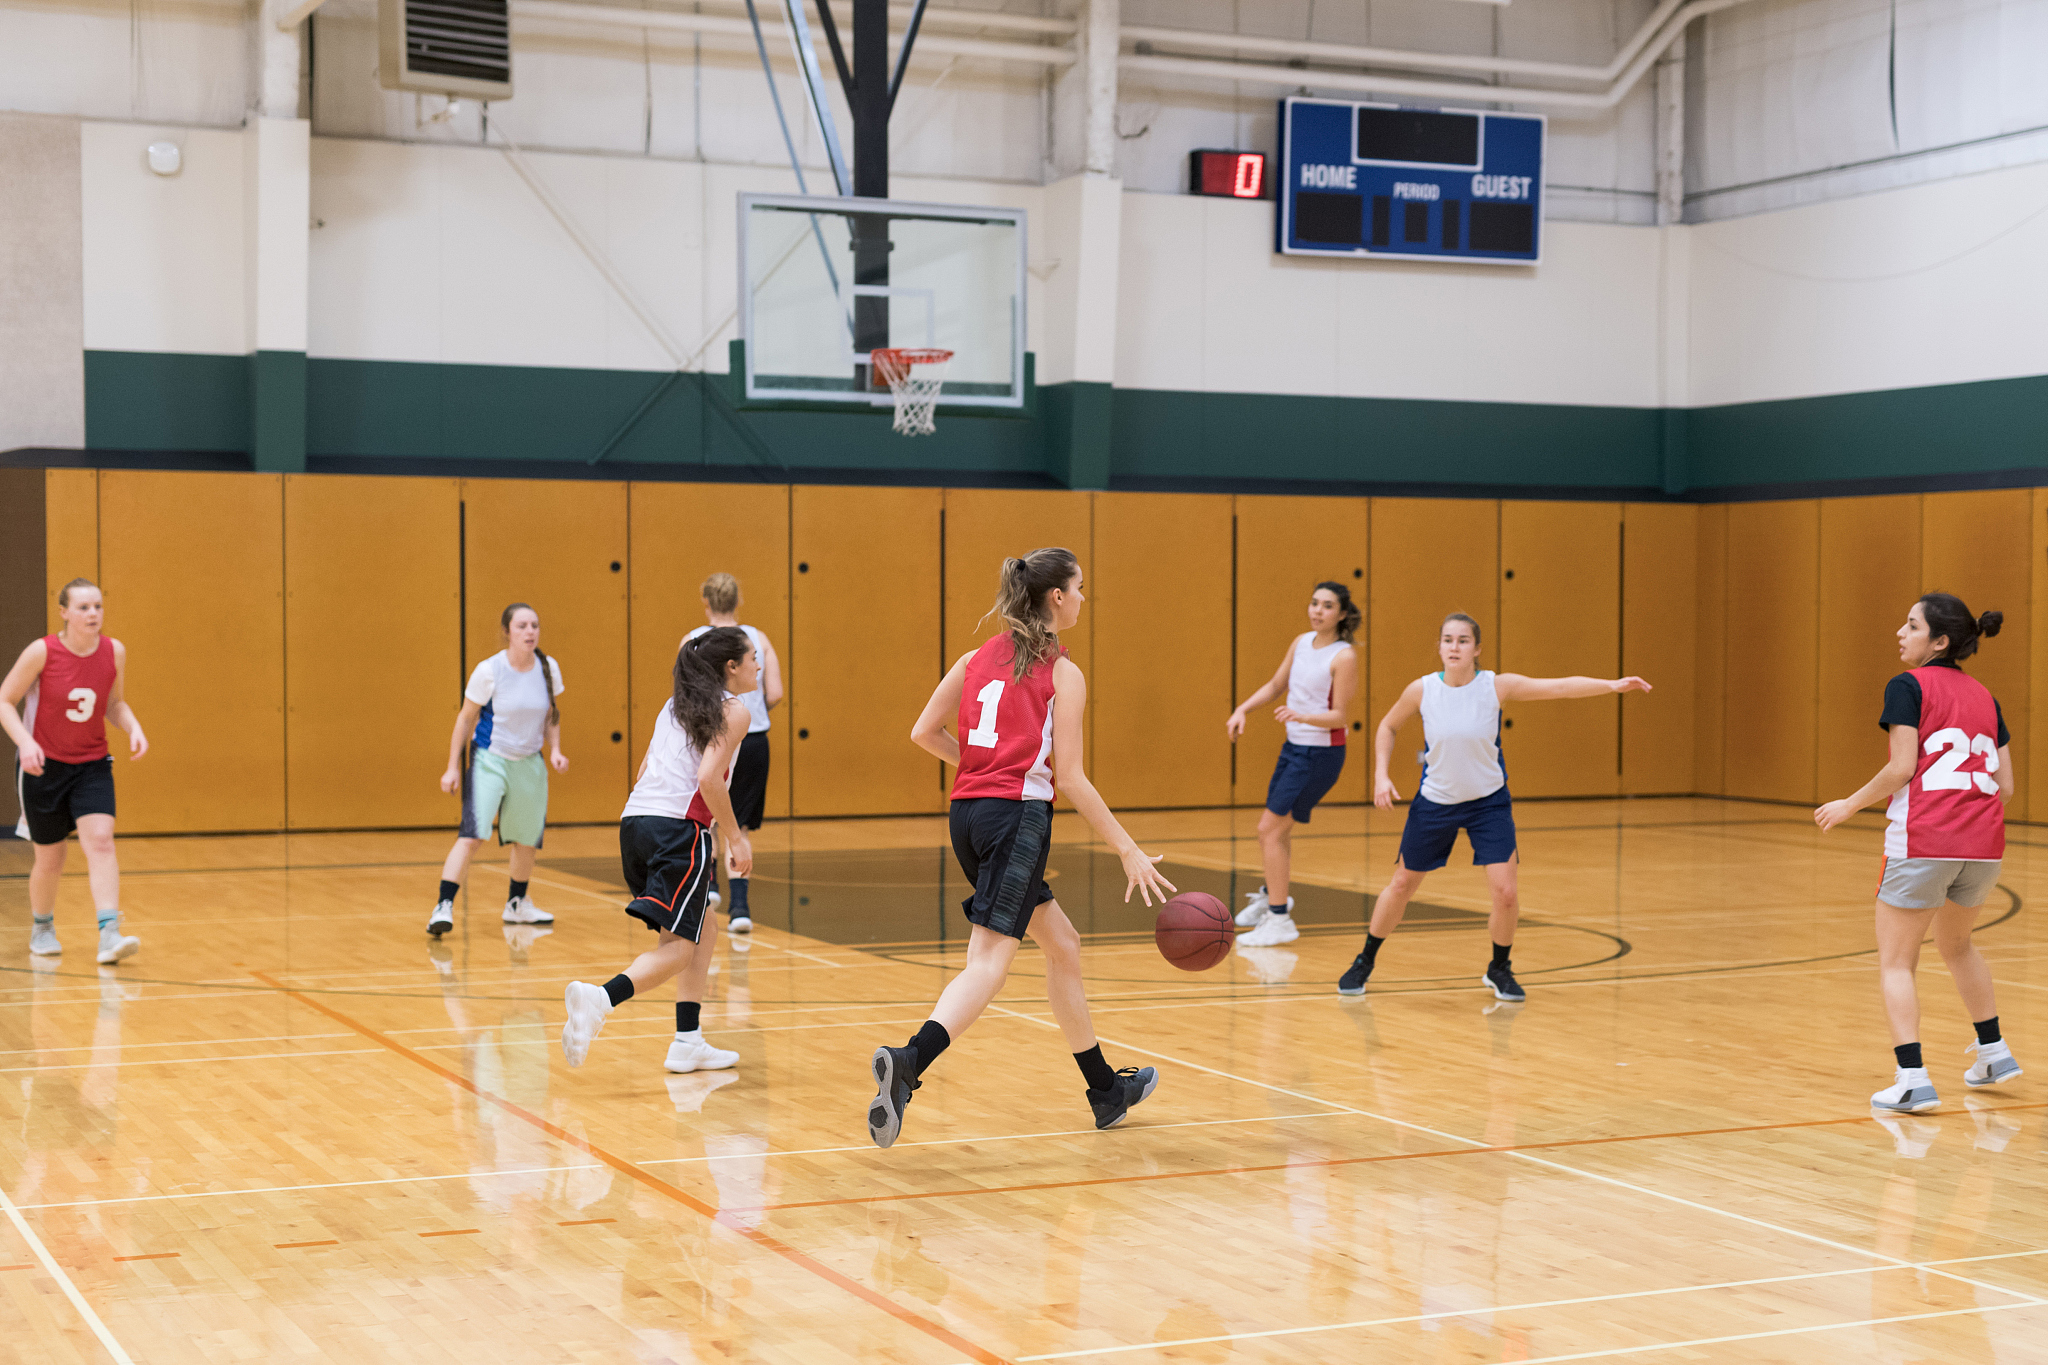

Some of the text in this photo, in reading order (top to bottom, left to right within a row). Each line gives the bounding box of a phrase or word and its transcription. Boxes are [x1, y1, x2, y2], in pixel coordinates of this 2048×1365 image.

[1234, 154, 1264, 198] 0
[1301, 164, 1357, 190] HOME
[1393, 182, 1440, 201] PERIOD
[1471, 174, 1532, 200] GUEST
[65, 687, 97, 723] 3
[968, 680, 1005, 748] 1
[1922, 727, 2000, 796] 23
